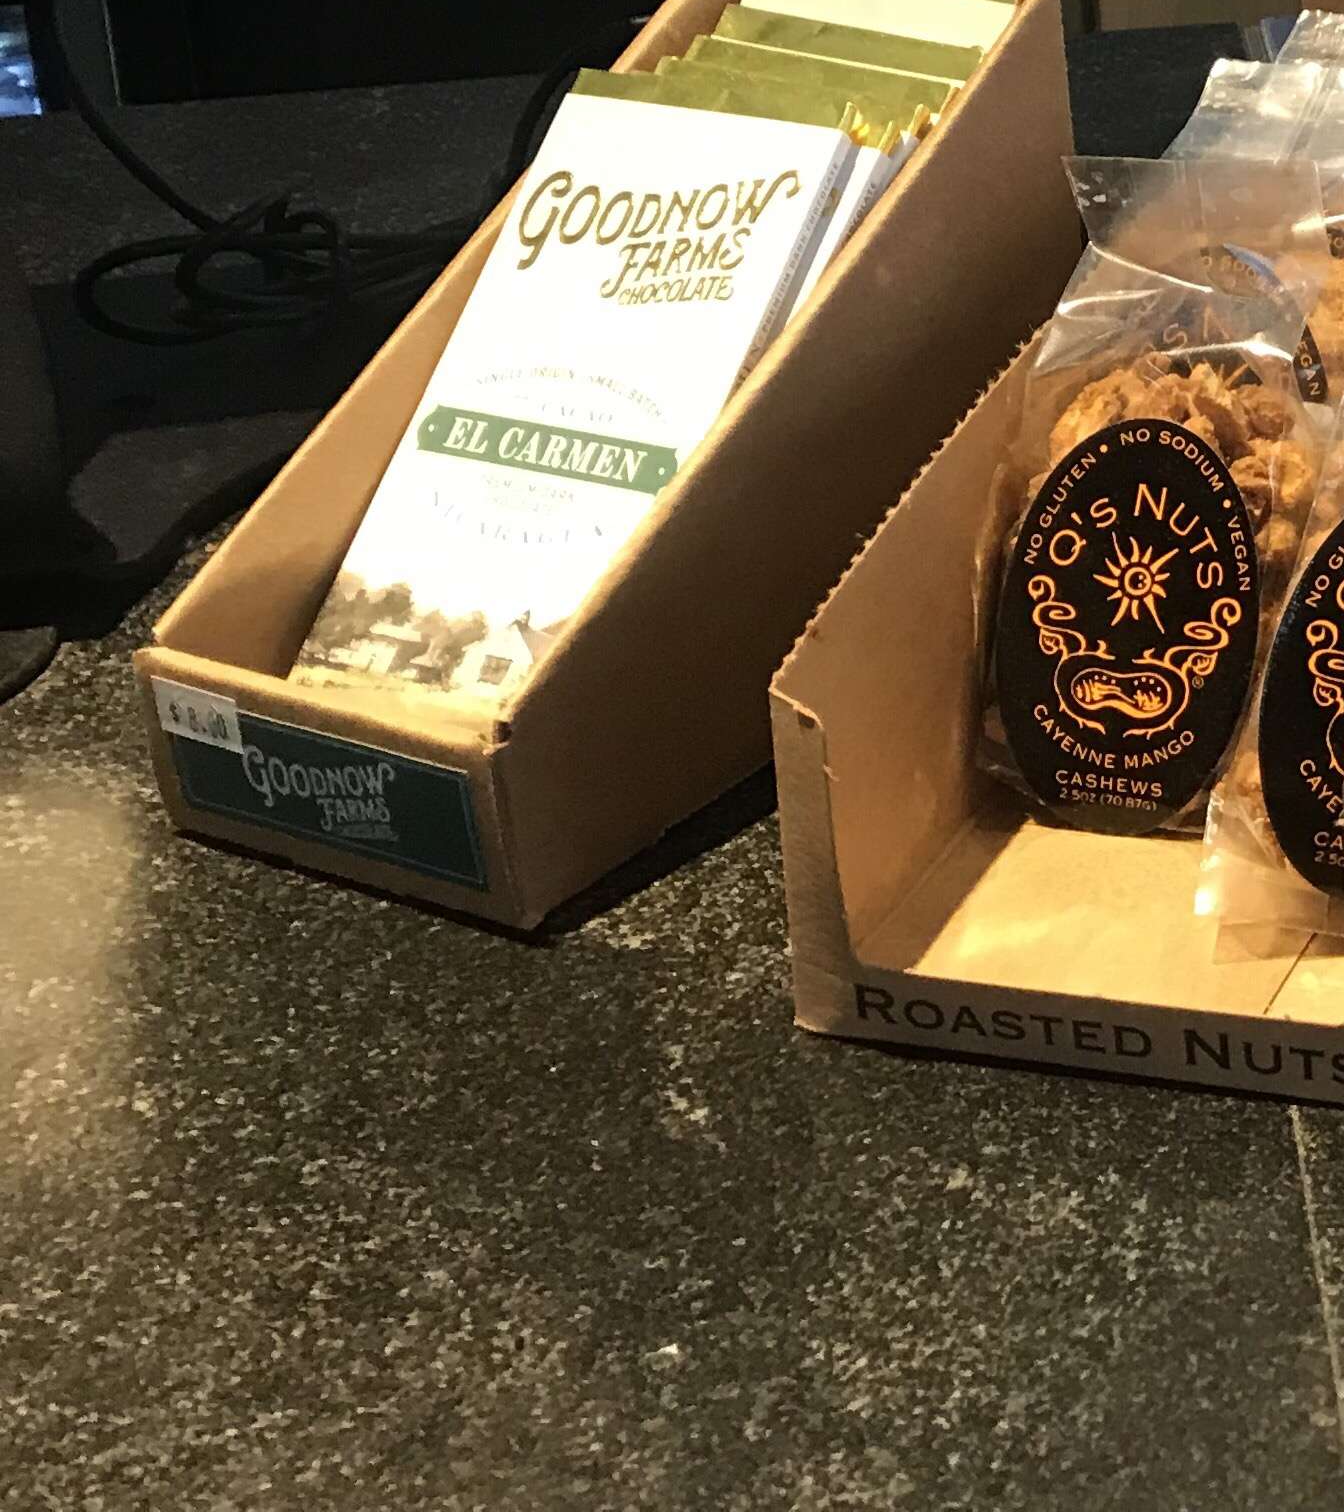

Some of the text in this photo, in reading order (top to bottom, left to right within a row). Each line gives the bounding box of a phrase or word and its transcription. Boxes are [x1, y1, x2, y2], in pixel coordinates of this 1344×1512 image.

[517, 169, 803, 270] GOODNOW
[599, 227, 752, 299] FARMS
[618, 273, 736, 306] CHOCOLATE
[442, 415, 649, 483] EL CARMEN
[1023, 427, 1252, 592] NO GLUTEN NO SODIUM VEGAN
[1048, 482, 1225, 590] Q'S NUTS
[1304, 573, 1331, 609] NO
[1032, 703, 1196, 770] CAYENNE MANGO
[241, 744, 397, 808] GOODNOW
[1055, 769, 1164, 798] CASHEWS
[314, 796, 392, 832] FARMS
[853, 983, 1154, 1060] ROASTED
